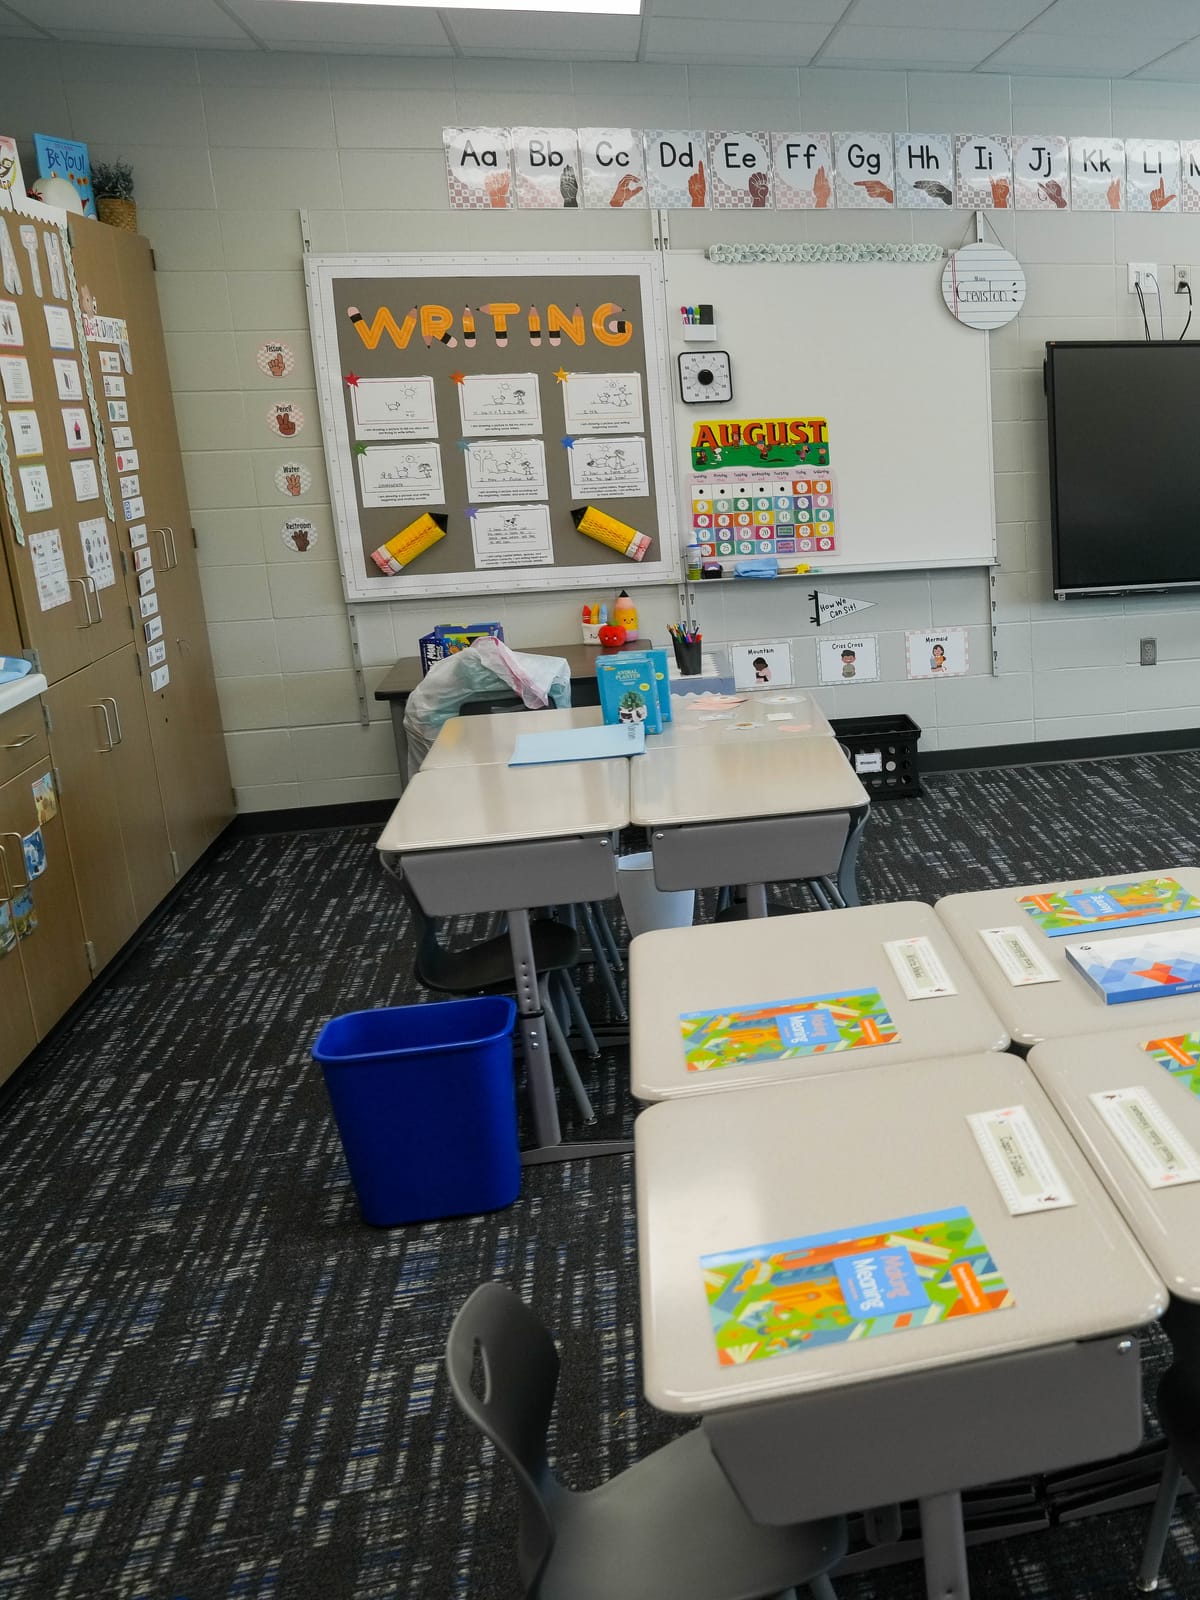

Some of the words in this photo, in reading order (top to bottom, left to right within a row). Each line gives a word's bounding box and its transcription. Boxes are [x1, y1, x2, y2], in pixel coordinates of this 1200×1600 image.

[460, 140, 498, 168] Aa
[529, 140, 564, 167] Bb
[595, 141, 631, 167] Cc
[660, 141, 694, 168] Dd
[725, 142, 757, 169] Ee
[786, 144, 817, 170] Ff
[848, 144, 882, 174] Gg
[908, 145, 940, 170] Hh
[974, 146, 993, 170] Ii
[1029, 147, 1051, 177] Jj
[1083, 148, 1112, 173] Kk
[1143, 151, 1163, 174] Ll
[956, 281, 1008, 302] Creviston
[347, 302, 633, 350] WRITING
[276, 405, 292, 413] Pencil
[696, 420, 827, 450] AUGUST
[820, 603, 835, 613] How
[836, 598, 846, 608] We
[829, 609, 843, 619] Can
[843, 603, 857, 615] Sit!
[789, 1015, 808, 1043] Meaning
[852, 1257, 885, 1311] Meaning
[880, 1255, 910, 1299] Making
